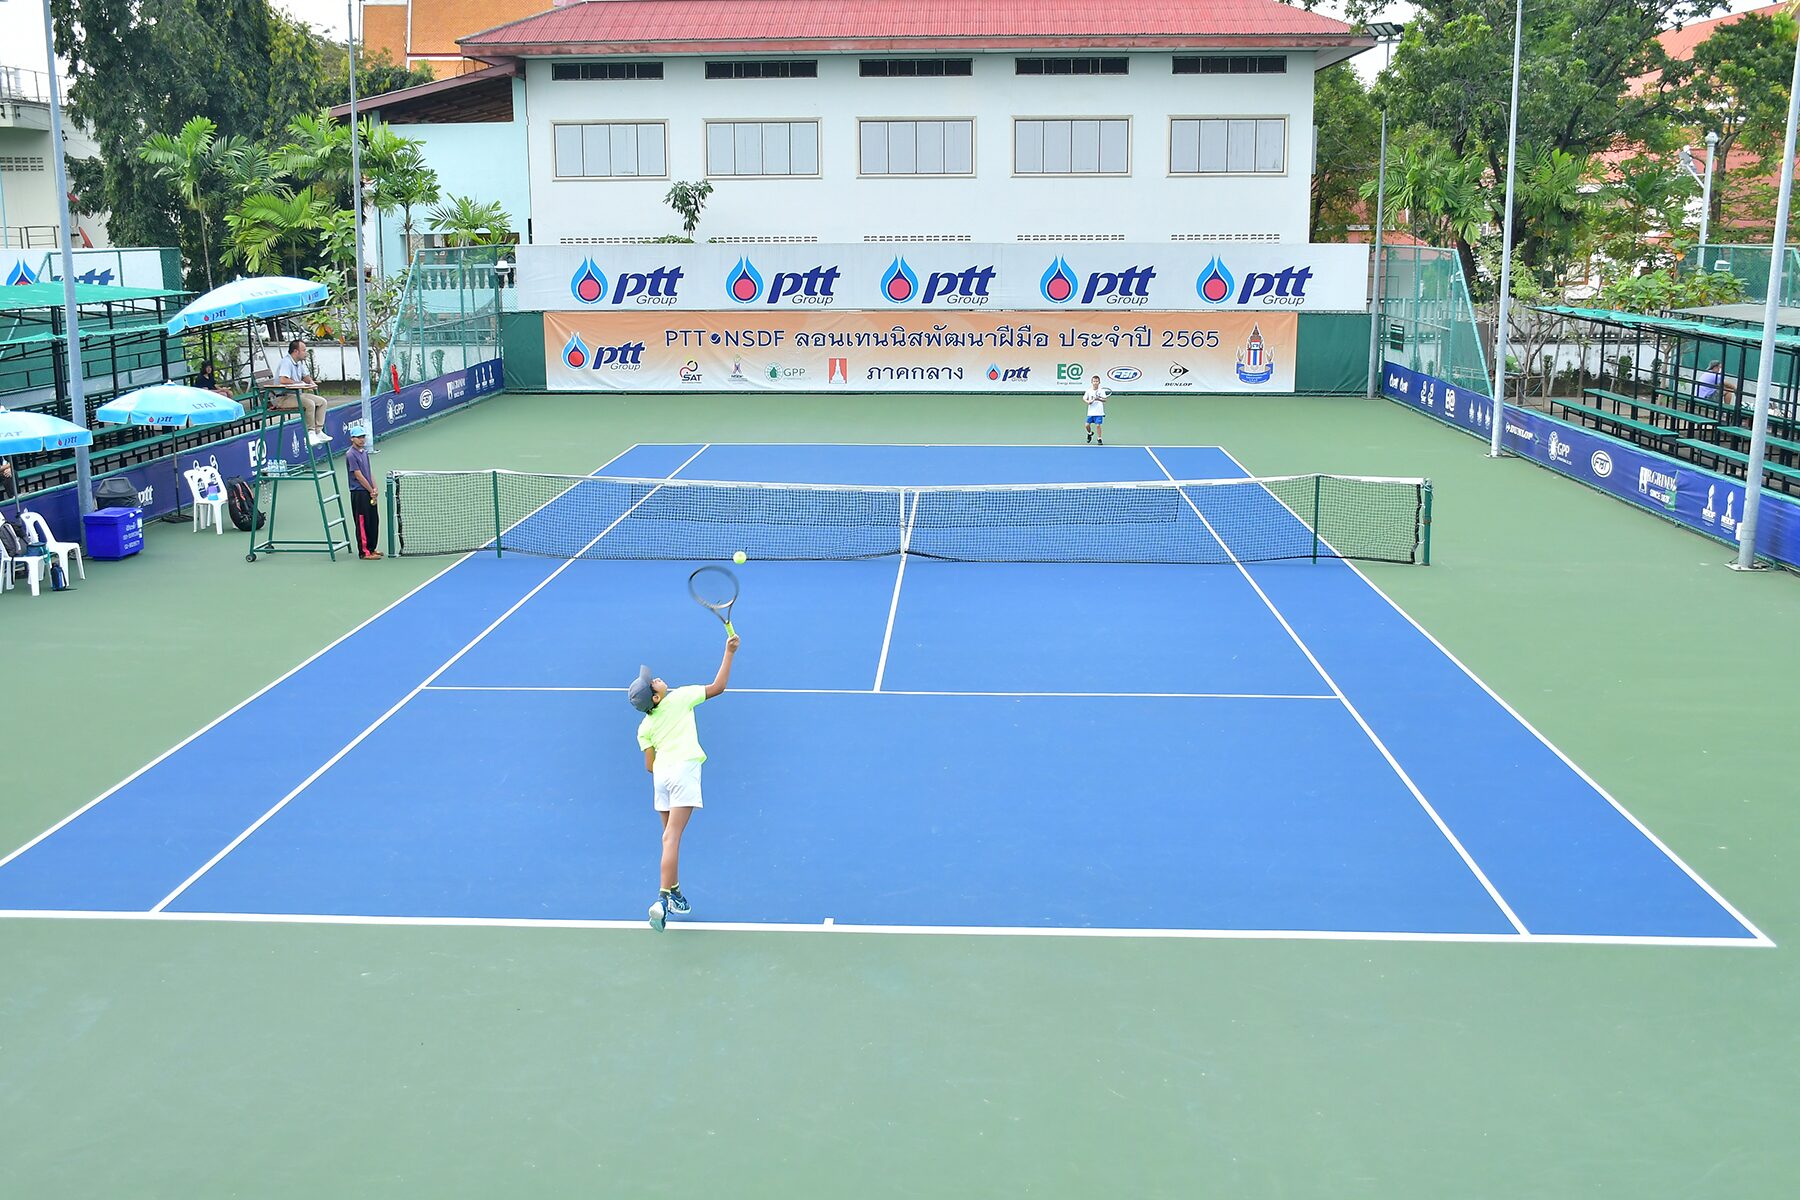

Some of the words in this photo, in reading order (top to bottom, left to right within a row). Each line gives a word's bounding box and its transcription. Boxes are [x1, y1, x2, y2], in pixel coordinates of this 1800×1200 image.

[53, 268, 115, 285] tt
[612, 265, 684, 304] ptt
[767, 265, 841, 304] ptt
[921, 265, 996, 304] ptt
[1081, 265, 1156, 304] ptt
[1237, 265, 1313, 304] ptt
[636, 295, 678, 307] Group
[792, 294, 834, 306] Group
[946, 294, 989, 306] Group
[1106, 294, 1149, 306] Group
[1263, 295, 1305, 307] Group
[212, 309, 226, 321] ptt
[795, 324, 1049, 347] ลอนเทนนิสพัฒนาฝีมือ
[1059, 325, 1151, 347] ประจำปี
[1162, 330, 1219, 348] 2565
[592, 341, 646, 369] ptt
[610, 362, 641, 371] Group
[783, 368, 806, 377] GPP
[867, 366, 963, 380] ภาคกลาง
[1002, 366, 1031, 381] ptt
[1057, 363, 1084, 380] E@
[682, 374, 702, 382] SAT
[394, 402, 405, 415] GPP
[157, 416, 173, 424] ptt
[1510, 424, 1533, 440] DUNLOP
[64, 436, 77, 446] ptt
[1557, 442, 1570, 457] GPP
